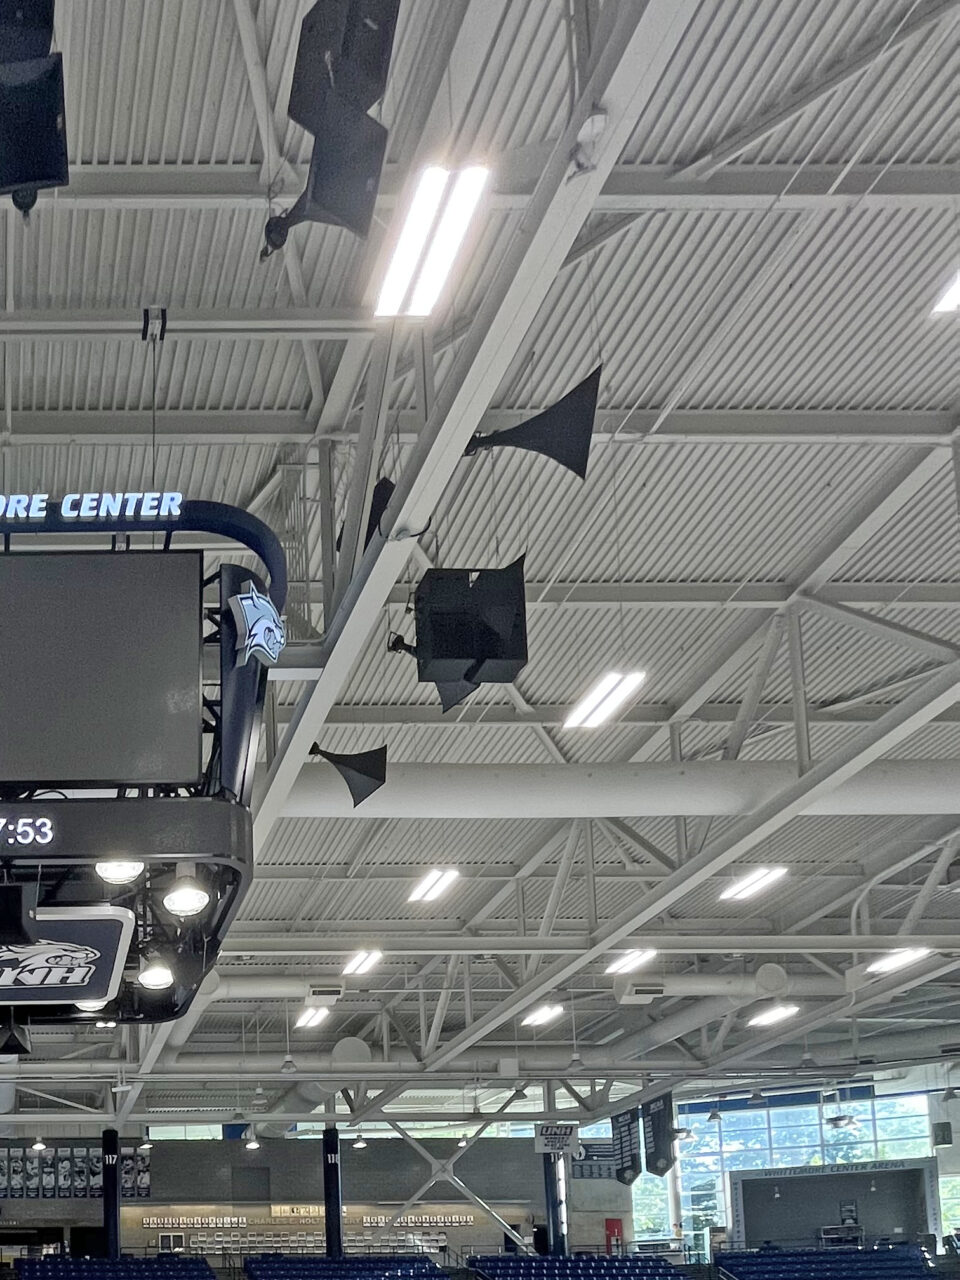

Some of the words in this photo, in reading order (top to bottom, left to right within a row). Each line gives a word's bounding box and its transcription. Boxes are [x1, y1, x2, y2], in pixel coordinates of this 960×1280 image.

[60, 492, 183, 517] CENTER
[541, 1126, 572, 1136] UNH
[105, 1154, 118, 1165] 117
[830, 1163, 868, 1172] CENTER
[871, 1160, 906, 1170] ARENA
